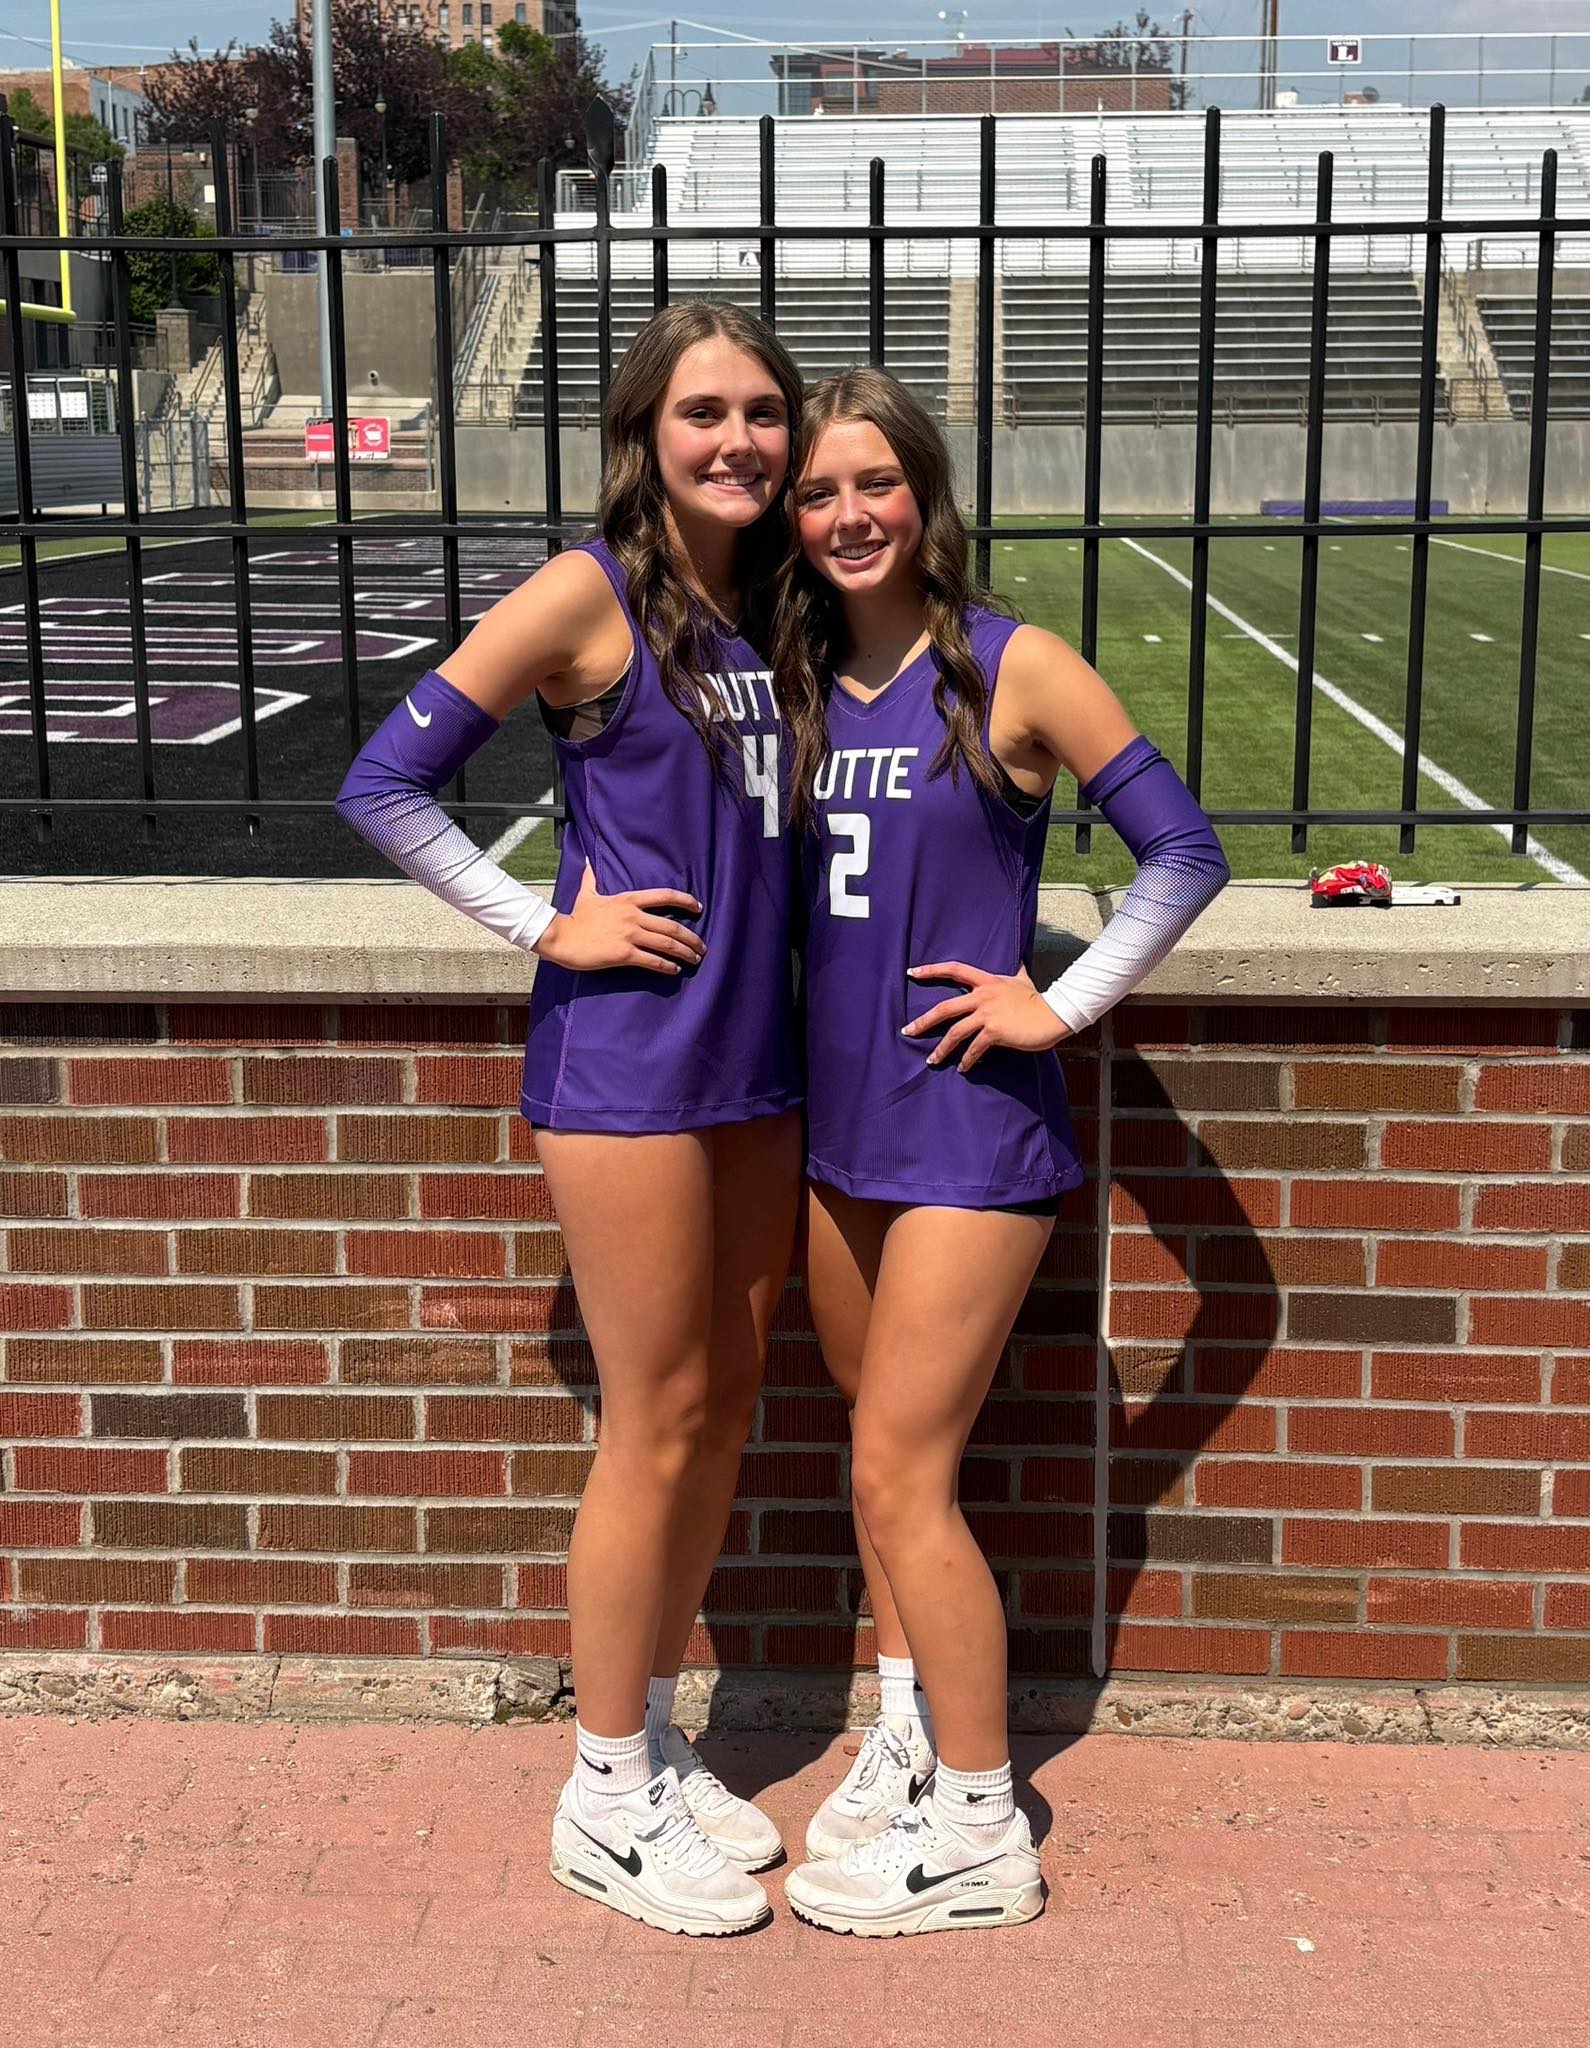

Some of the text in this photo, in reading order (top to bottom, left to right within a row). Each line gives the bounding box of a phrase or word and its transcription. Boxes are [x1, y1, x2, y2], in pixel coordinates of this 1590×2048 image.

[741, 251, 759, 265] A
[697, 671, 780, 722] UTT
[742, 734, 779, 838] 4
[814, 747, 919, 800] UTTE
[827, 813, 871, 918] 2
[648, 1777, 665, 1798] NIKE
